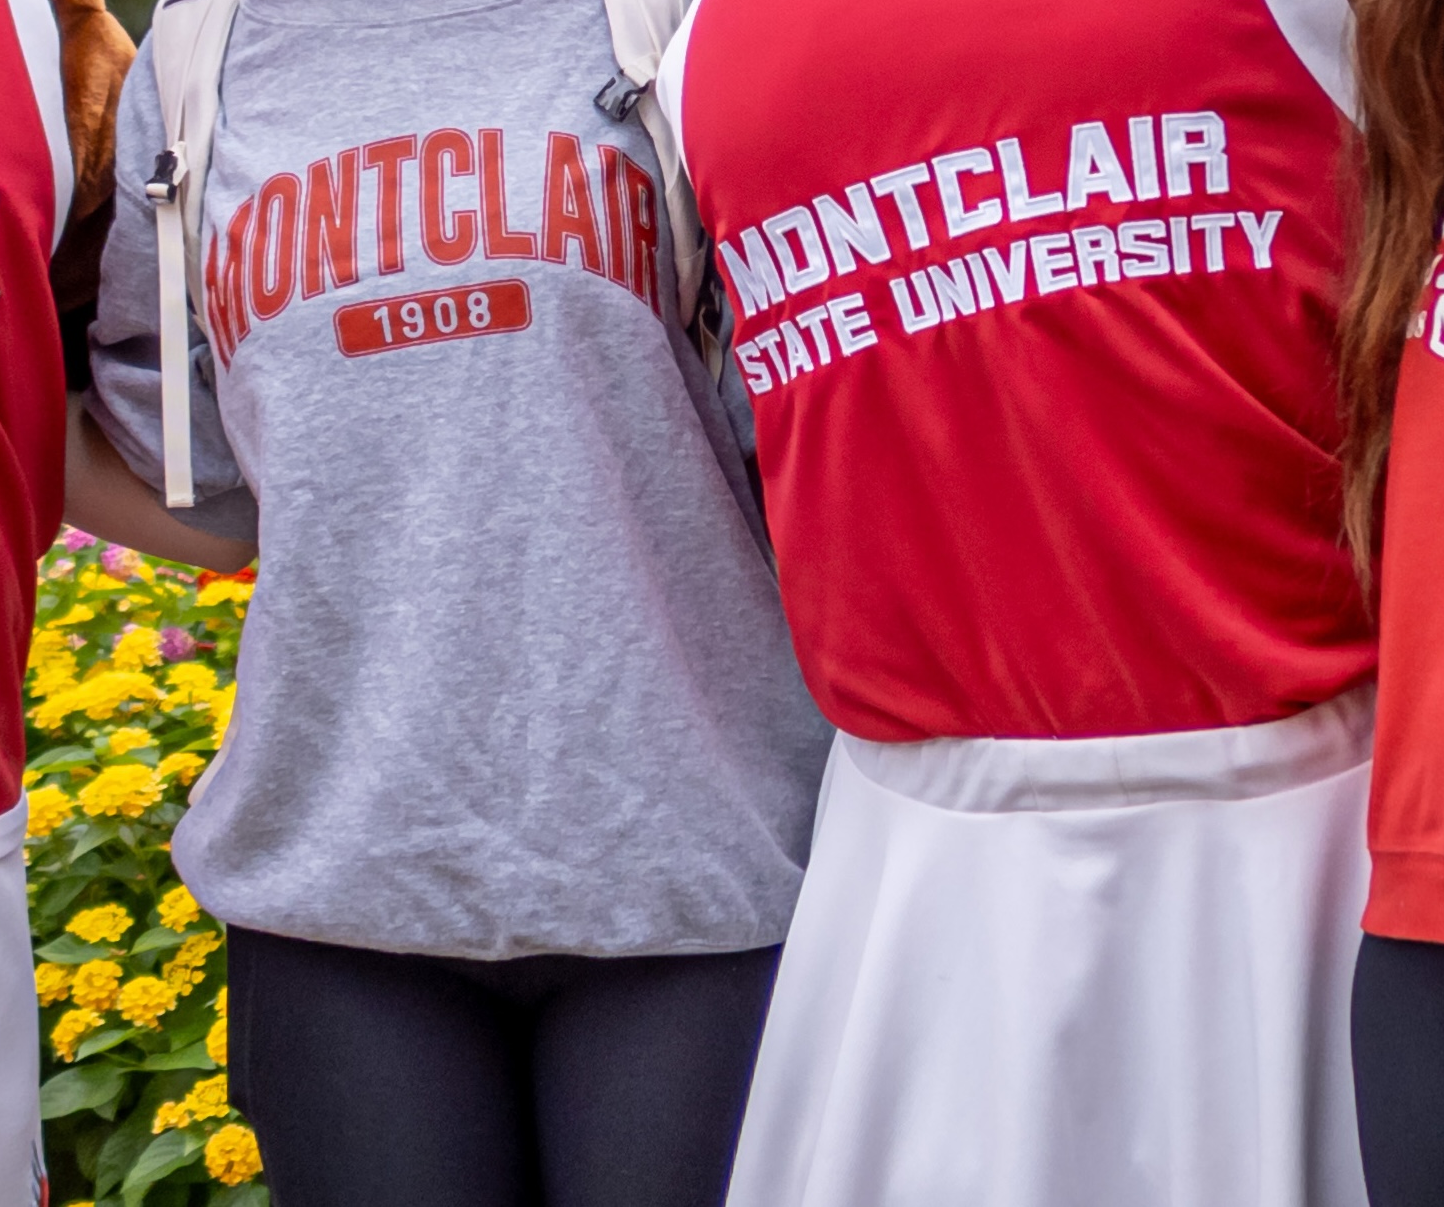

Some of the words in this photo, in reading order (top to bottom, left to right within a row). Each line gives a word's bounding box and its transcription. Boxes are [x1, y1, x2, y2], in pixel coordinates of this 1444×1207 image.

[204, 127, 663, 374] MONTCLAIR
[718, 109, 1230, 318] MONTCLAIR
[735, 293, 878, 395] STATE
[890, 210, 1283, 335] UNIVERSITY
[372, 290, 492, 343] 1908
